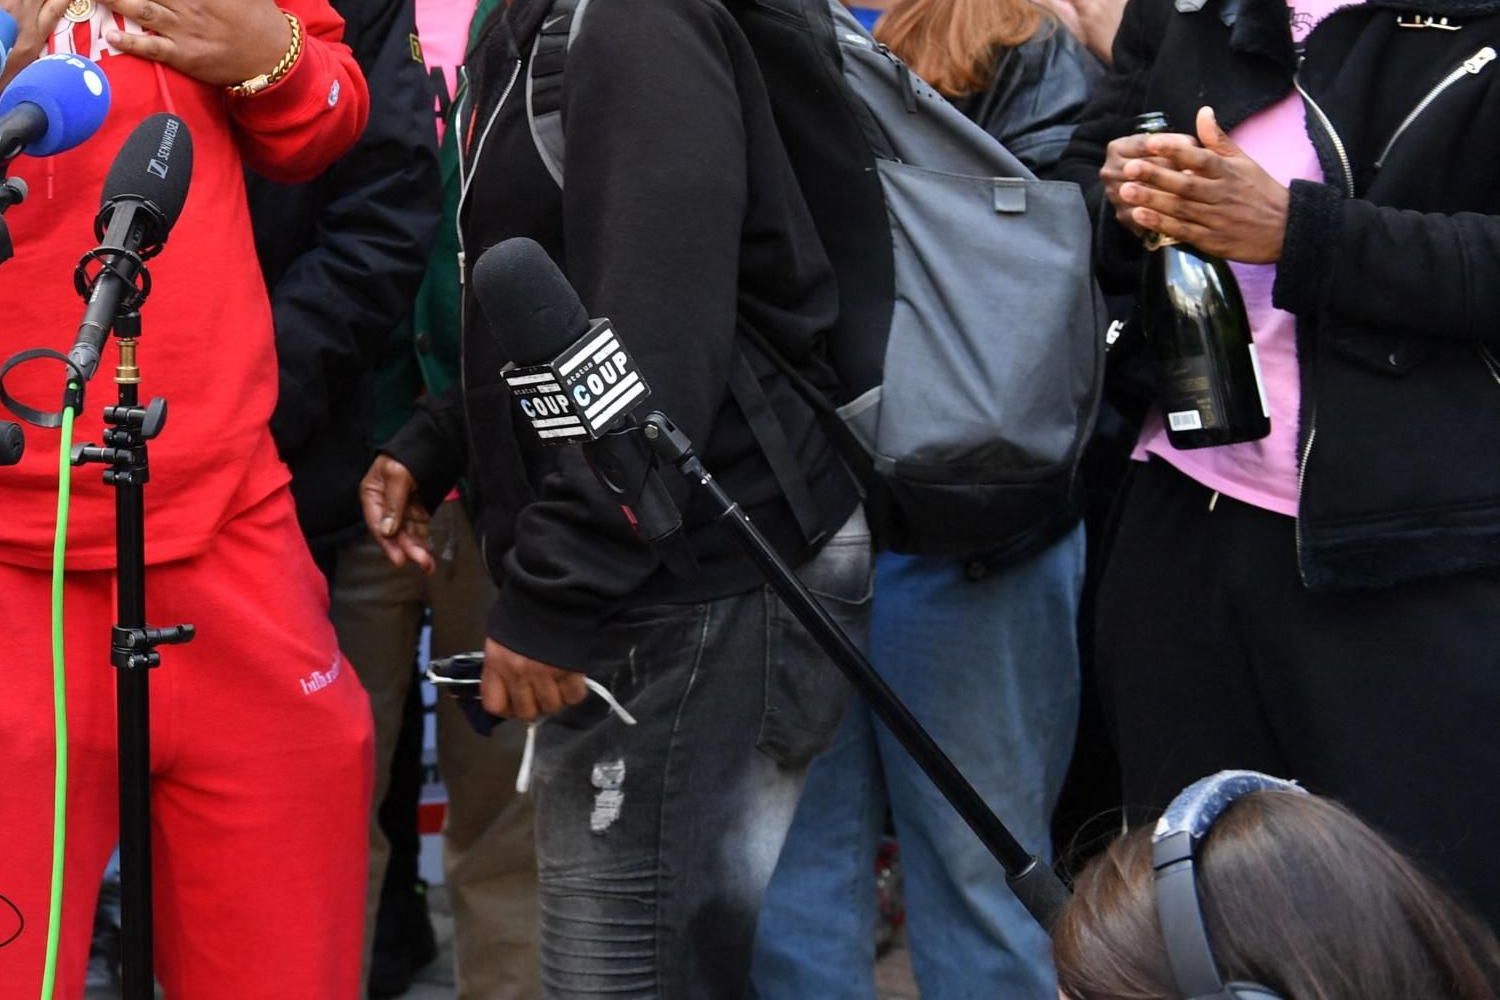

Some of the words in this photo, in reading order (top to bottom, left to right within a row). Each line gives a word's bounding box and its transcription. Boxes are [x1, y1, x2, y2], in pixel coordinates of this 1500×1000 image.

[157, 118, 179, 161] SENNHEISER
[566, 360, 594, 386] status
[572, 351, 628, 407] COUP
[520, 394, 570, 418] COUP
